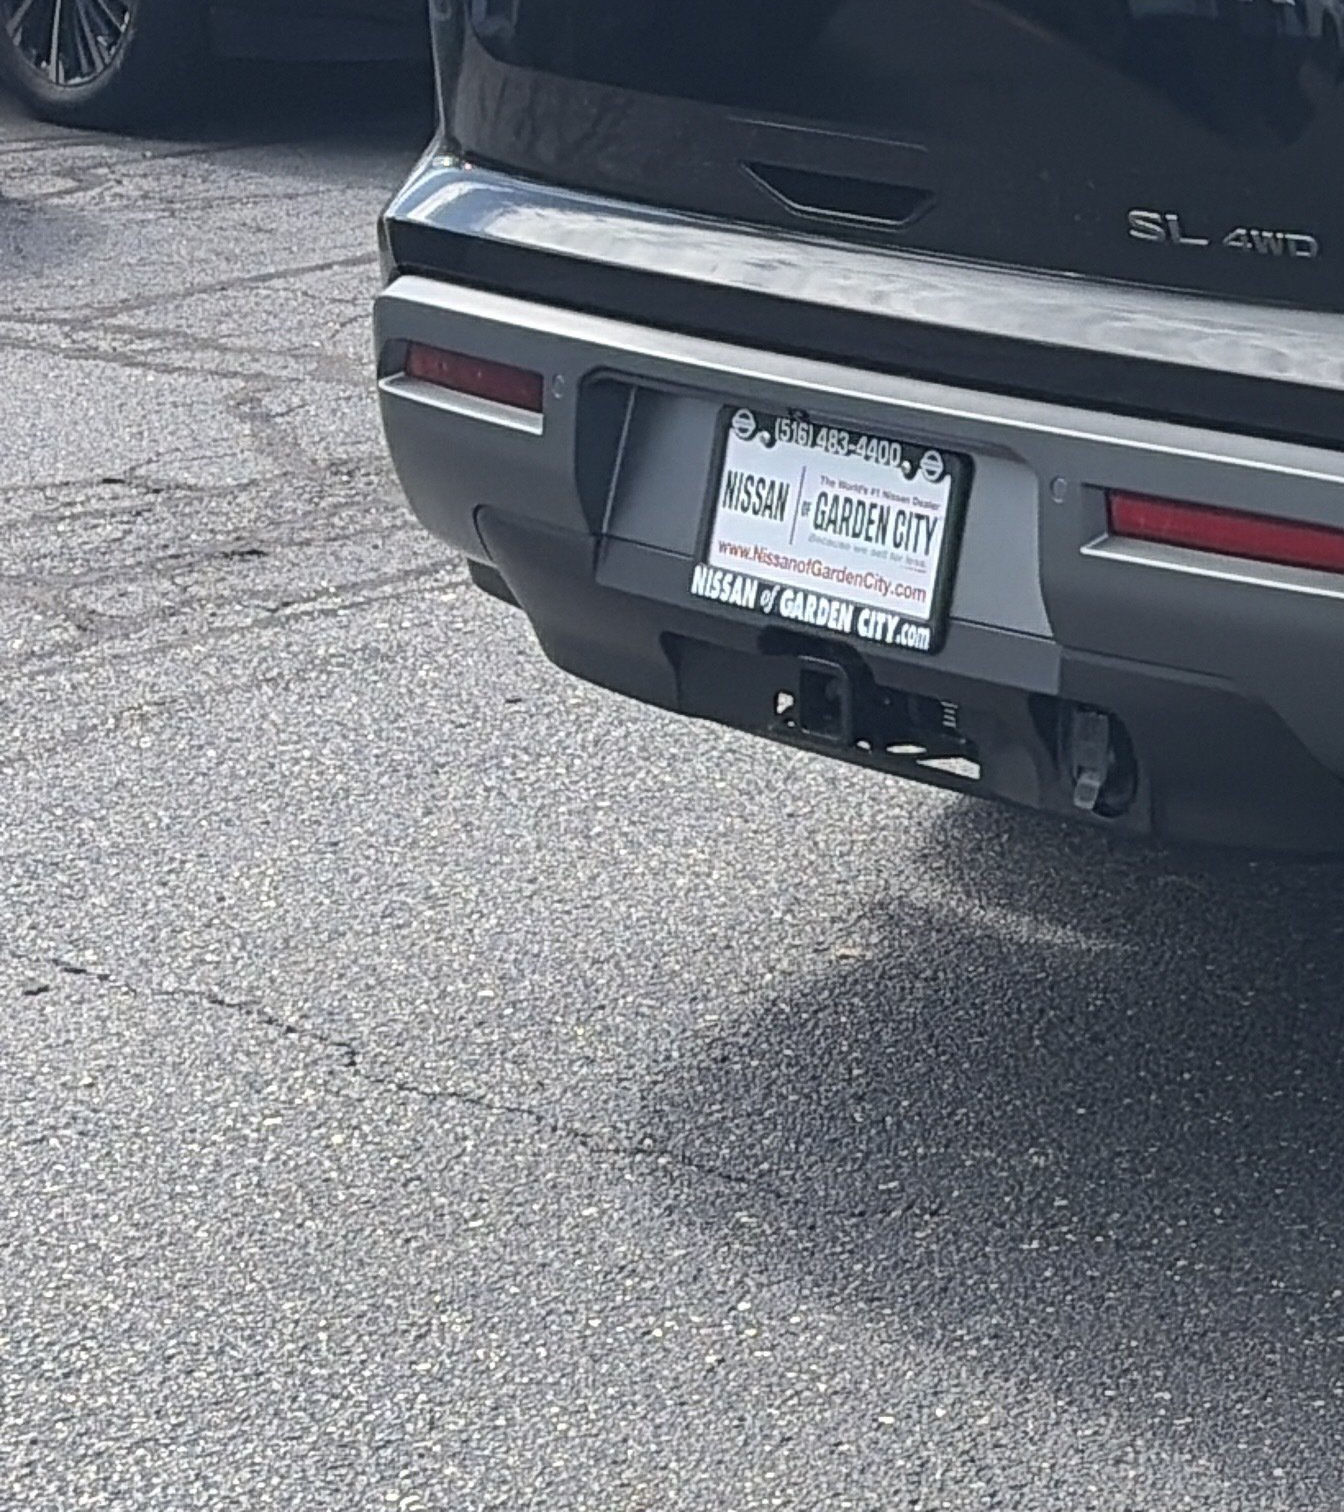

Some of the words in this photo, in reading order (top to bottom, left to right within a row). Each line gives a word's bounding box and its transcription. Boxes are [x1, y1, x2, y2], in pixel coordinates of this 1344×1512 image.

[1128, 208, 1209, 246] SL
[1222, 227, 1320, 258] 4WD
[774, 417, 815, 448] (516)
[815, 425, 902, 468] 483-4400
[722, 469, 790, 523] NISSAN
[813, 491, 891, 547] GARDEN
[892, 508, 939, 557] CITY
[820, 475, 836, 488] The
[882, 490, 911, 505] Nissan
[912, 496, 942, 511] Dealer
[718, 540, 927, 603] www.NissanofGardenCity.com
[690, 564, 759, 610] NISSAN
[760, 584, 781, 615] of
[779, 588, 855, 634] GARDEN
[857, 607, 931, 651] CITY.com
